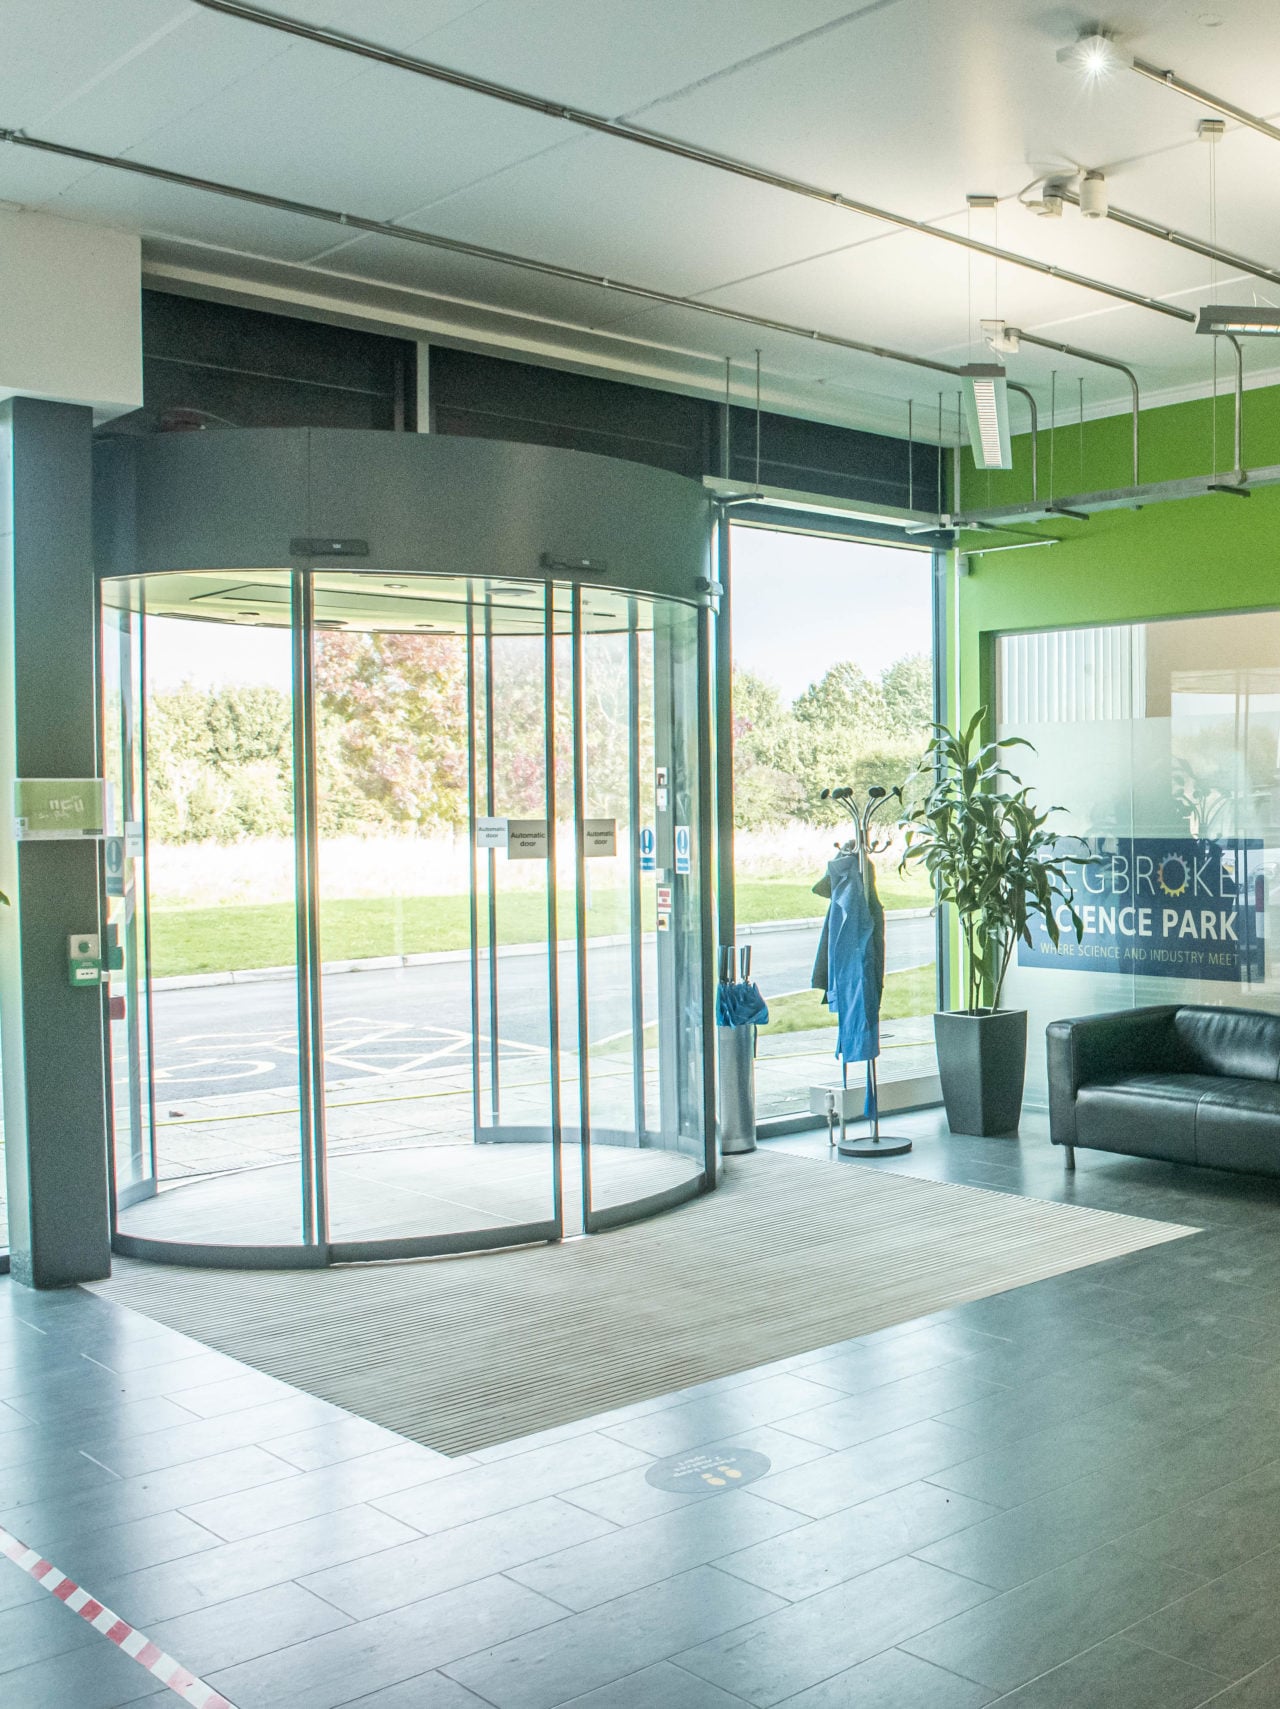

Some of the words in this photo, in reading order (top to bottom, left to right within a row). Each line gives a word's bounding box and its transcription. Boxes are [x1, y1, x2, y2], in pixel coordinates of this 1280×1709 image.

[1162, 908, 1239, 941] PARK
[1040, 942, 1075, 957] WHERE
[1078, 944, 1120, 959] SCIENCE
[1123, 946, 1147, 960] AND
[1150, 948, 1204, 964] INDUSTRY
[1208, 952, 1239, 966] MEET
